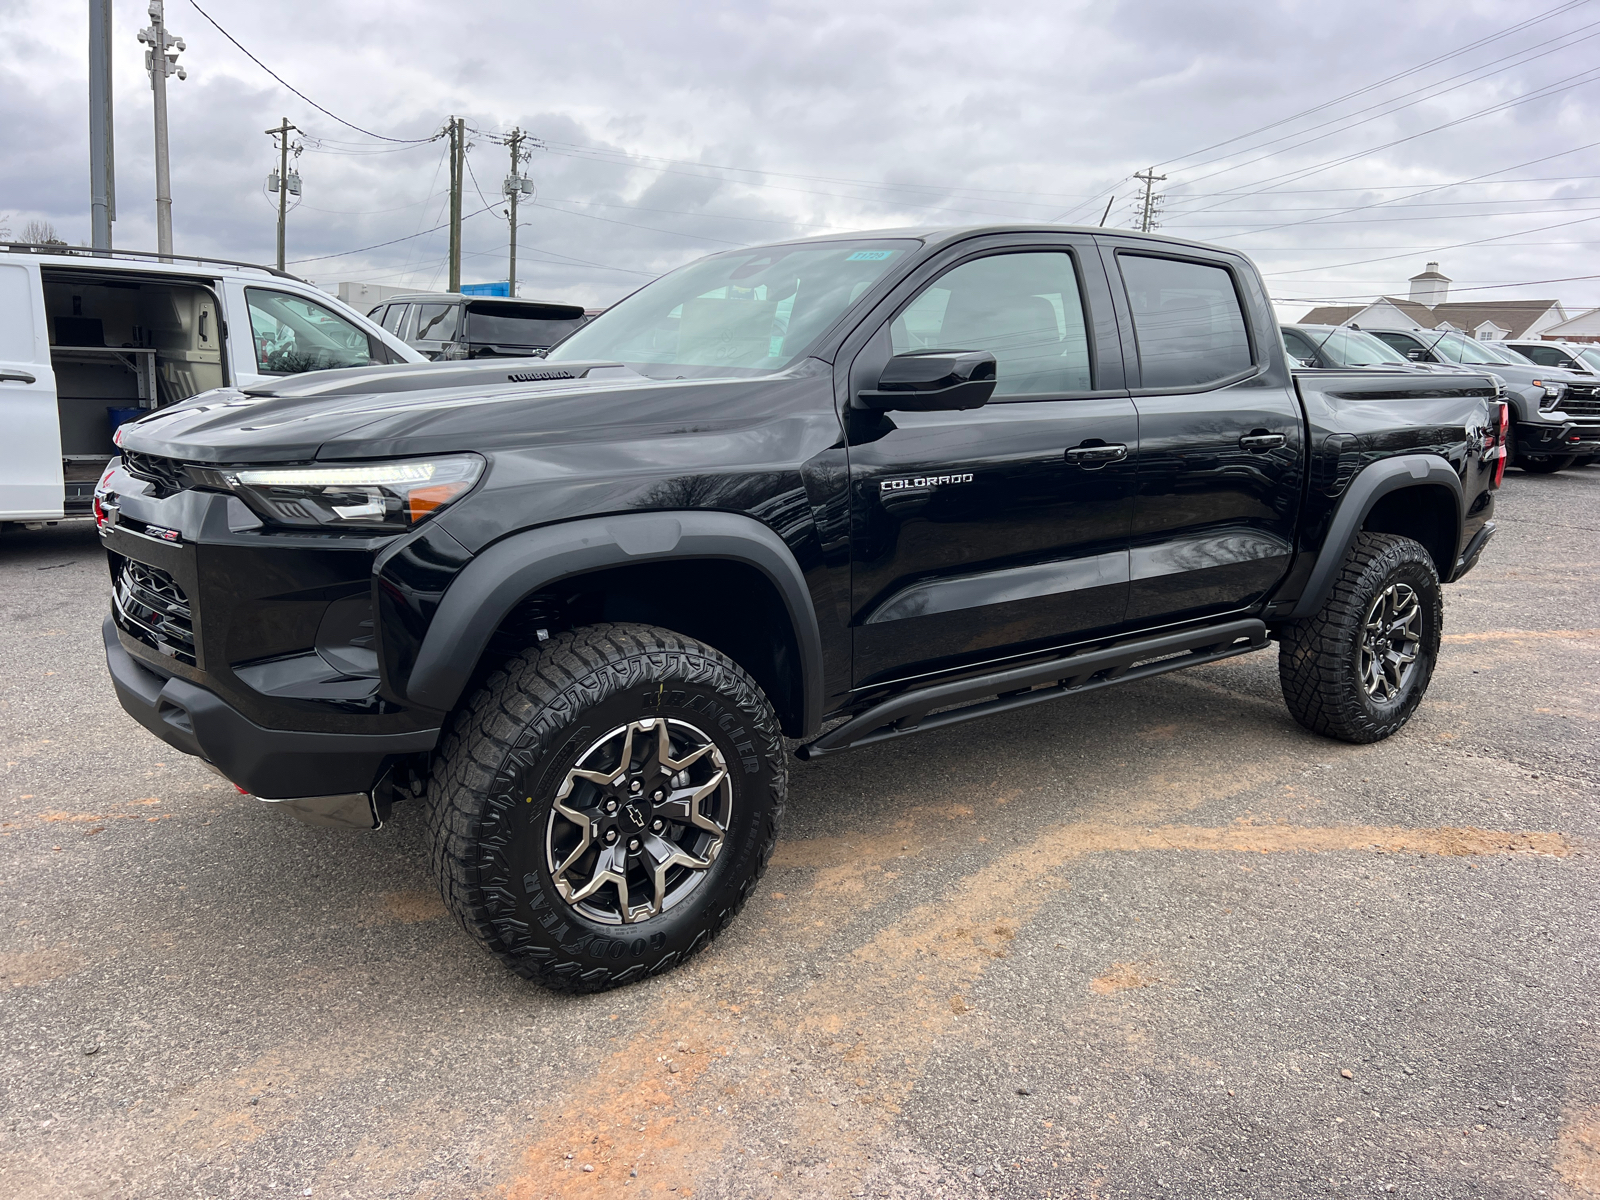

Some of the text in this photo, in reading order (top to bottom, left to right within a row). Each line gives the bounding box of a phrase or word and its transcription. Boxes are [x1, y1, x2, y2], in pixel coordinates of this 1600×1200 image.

[507, 370, 576, 383] TURBOMAX
[880, 473, 974, 491] COLORADO
[642, 689, 761, 775] WRANGLER
[522, 870, 667, 959] GOODYEAR
